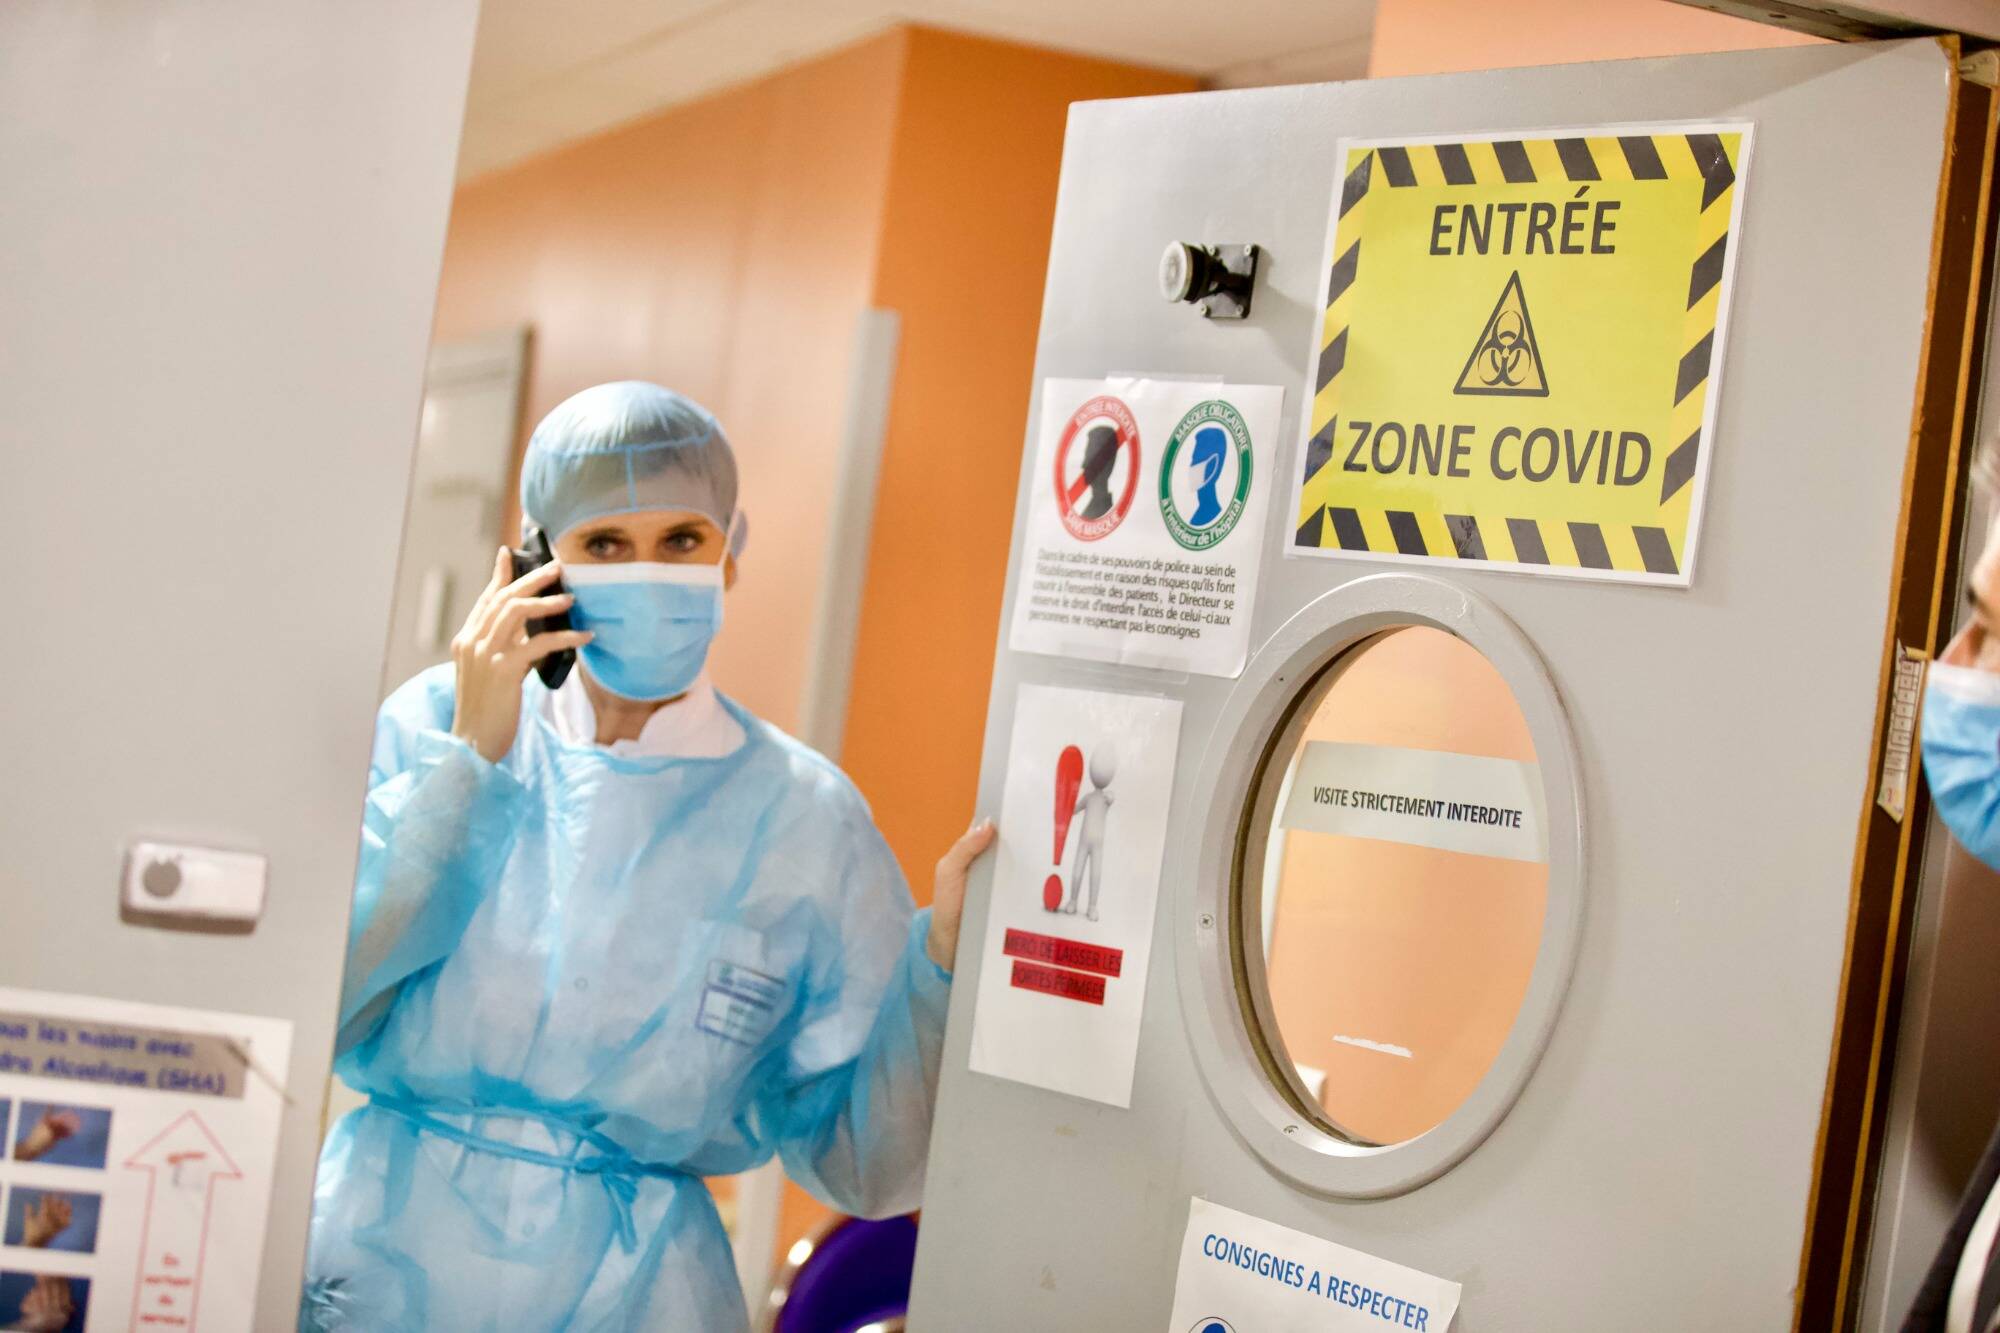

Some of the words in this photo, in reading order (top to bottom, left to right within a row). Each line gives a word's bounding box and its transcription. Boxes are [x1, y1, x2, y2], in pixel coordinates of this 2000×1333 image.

[1429, 185, 1621, 256] ENTRÉE
[1175, 405, 1208, 443] MASQUE
[1208, 403, 1249, 451] OBLIGATOIRE
[1343, 421, 1475, 478] ZONE
[1489, 426, 1652, 486] COVID
[1197, 533, 1210, 546] de
[1067, 551, 1088, 564] cadre
[1089, 554, 1099, 565] de
[1102, 556, 1114, 566] ses
[1114, 557, 1151, 569] pouvoirs
[1152, 558, 1163, 571] de
[1164, 559, 1191, 576] police
[1191, 565, 1203, 575] au
[1205, 564, 1223, 577] sein
[1224, 565, 1236, 578] de
[1094, 571, 1103, 580] et
[1104, 573, 1114, 582] en
[1115, 573, 1141, 584] raison
[1142, 574, 1157, 587] des
[1159, 576, 1190, 591] risques
[1191, 578, 1215, 593] qu'ils
[1216, 580, 1235, 594] font
[1061, 596, 1069, 608] le
[1071, 598, 1090, 610] droit
[1092, 600, 1135, 616] d'interdire
[1166, 606, 1178, 621] de
[1179, 609, 1214, 625] celui-ci
[1214, 613, 1232, 626] aux
[1108, 586, 1123, 598] des
[1167, 591, 1177, 605] le
[1178, 592, 1221, 609] Directeur
[1223, 599, 1235, 611] se
[1071, 615, 1082, 625] ne
[1083, 616, 1128, 630] respectant
[1128, 622, 1143, 634] pas
[1144, 620, 1155, 634] les
[1156, 623, 1201, 640] consignes
[1314, 786, 1349, 807] VISITE
[1351, 791, 1445, 819] STRICTEMENT
[1447, 803, 1523, 829] INTERDITE
[1055, 944, 1100, 968] LAISSER
[1203, 1234, 1305, 1288] CONSIGNES
[1307, 1270, 1321, 1296] A
[1326, 1275, 1429, 1333] RESPECTER
